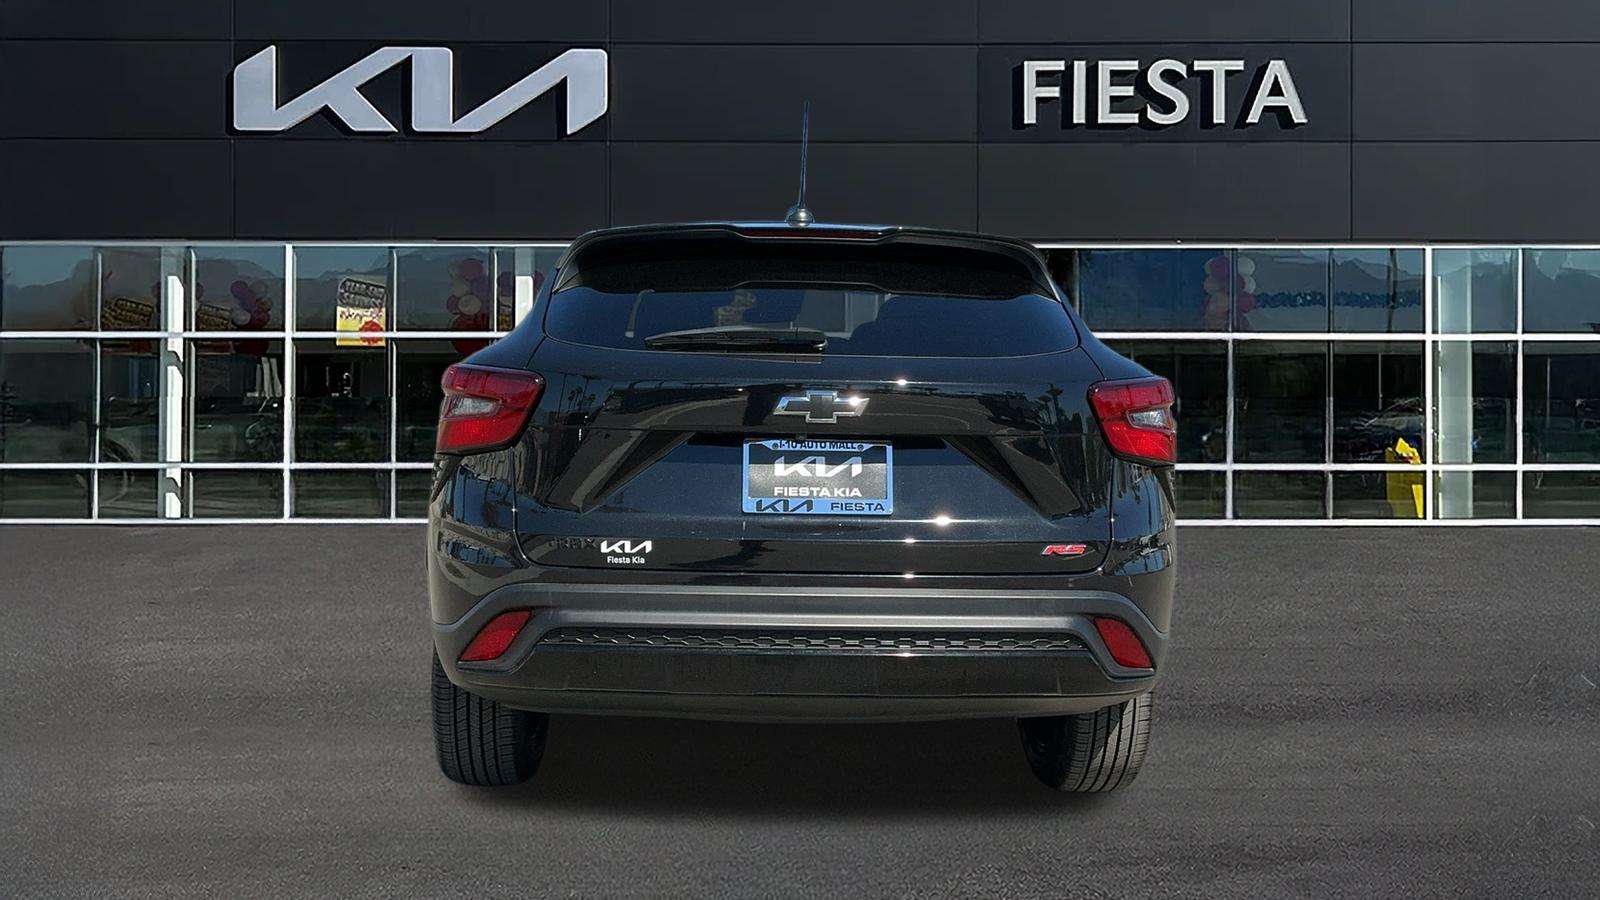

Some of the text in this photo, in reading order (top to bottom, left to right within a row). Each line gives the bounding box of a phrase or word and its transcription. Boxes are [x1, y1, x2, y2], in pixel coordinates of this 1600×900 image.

[234, 45, 608, 135] KIA
[1024, 59, 1308, 125] FIESTA
[800, 441, 827, 449] AUTO
[829, 442, 857, 450] MALL
[774, 456, 862, 478] KIA
[774, 487, 862, 497] FIESTA KIA
[756, 499, 885, 512] KIA FIESTA
[600, 540, 652, 553] KIA
[1042, 545, 1087, 555] RS
[607, 555, 645, 564] Fiesta Kia
